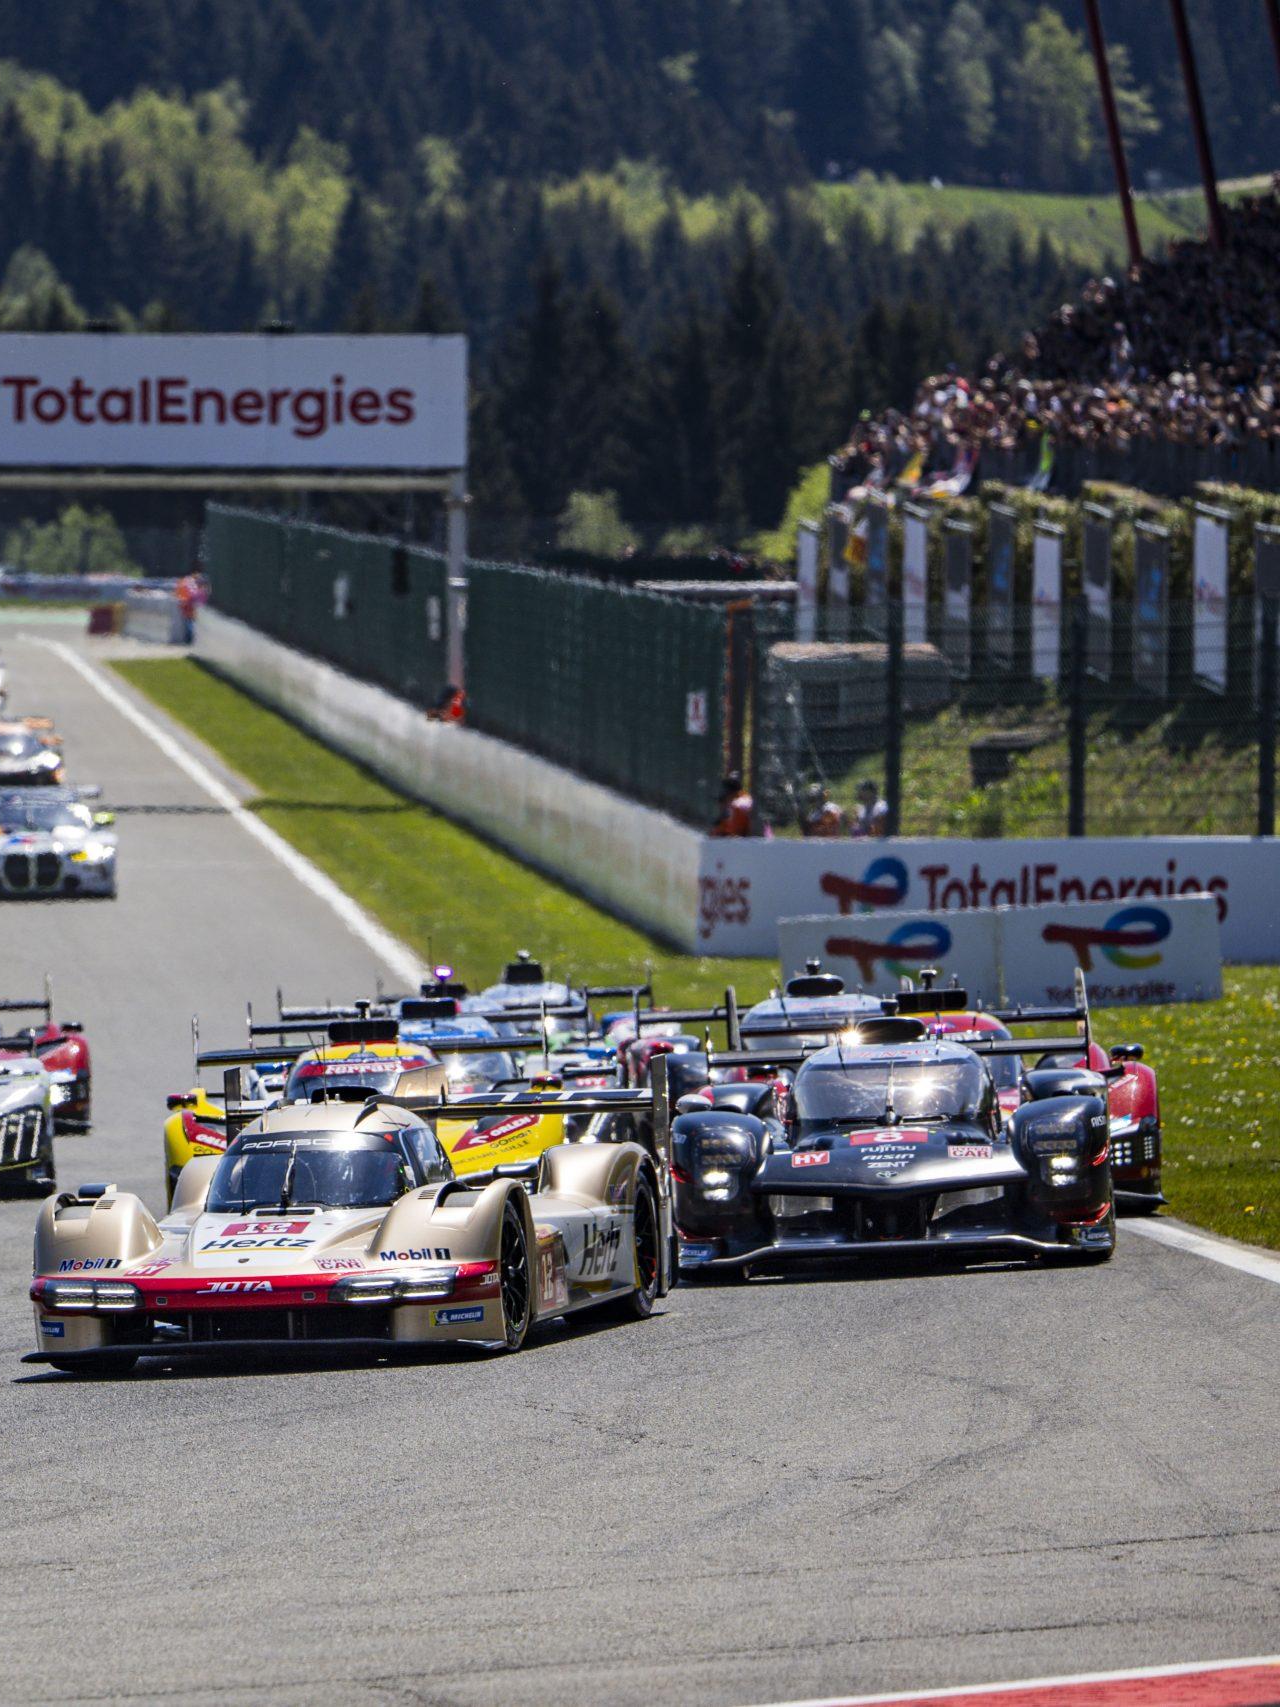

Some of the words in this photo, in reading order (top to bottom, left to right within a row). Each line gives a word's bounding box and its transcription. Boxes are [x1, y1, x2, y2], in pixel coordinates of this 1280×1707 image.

[0, 374, 417, 438] TotalEnergies
[489, 1116, 532, 1137] ORLEN
[873, 1131, 904, 1143] 8
[241, 1139, 355, 1151] PORSC
[860, 1143, 917, 1154] FUJITSU
[794, 1153, 826, 1166] HY
[952, 1150, 989, 1158] CAR
[867, 1160, 910, 1169] ZENT
[200, 1237, 316, 1251] Hertz
[380, 1248, 432, 1262] Mobil
[59, 1258, 105, 1273] Mobil
[320, 1262, 362, 1270] CAR
[196, 1280, 273, 1295] JOTA
[450, 1310, 482, 1321] MICHELIN
